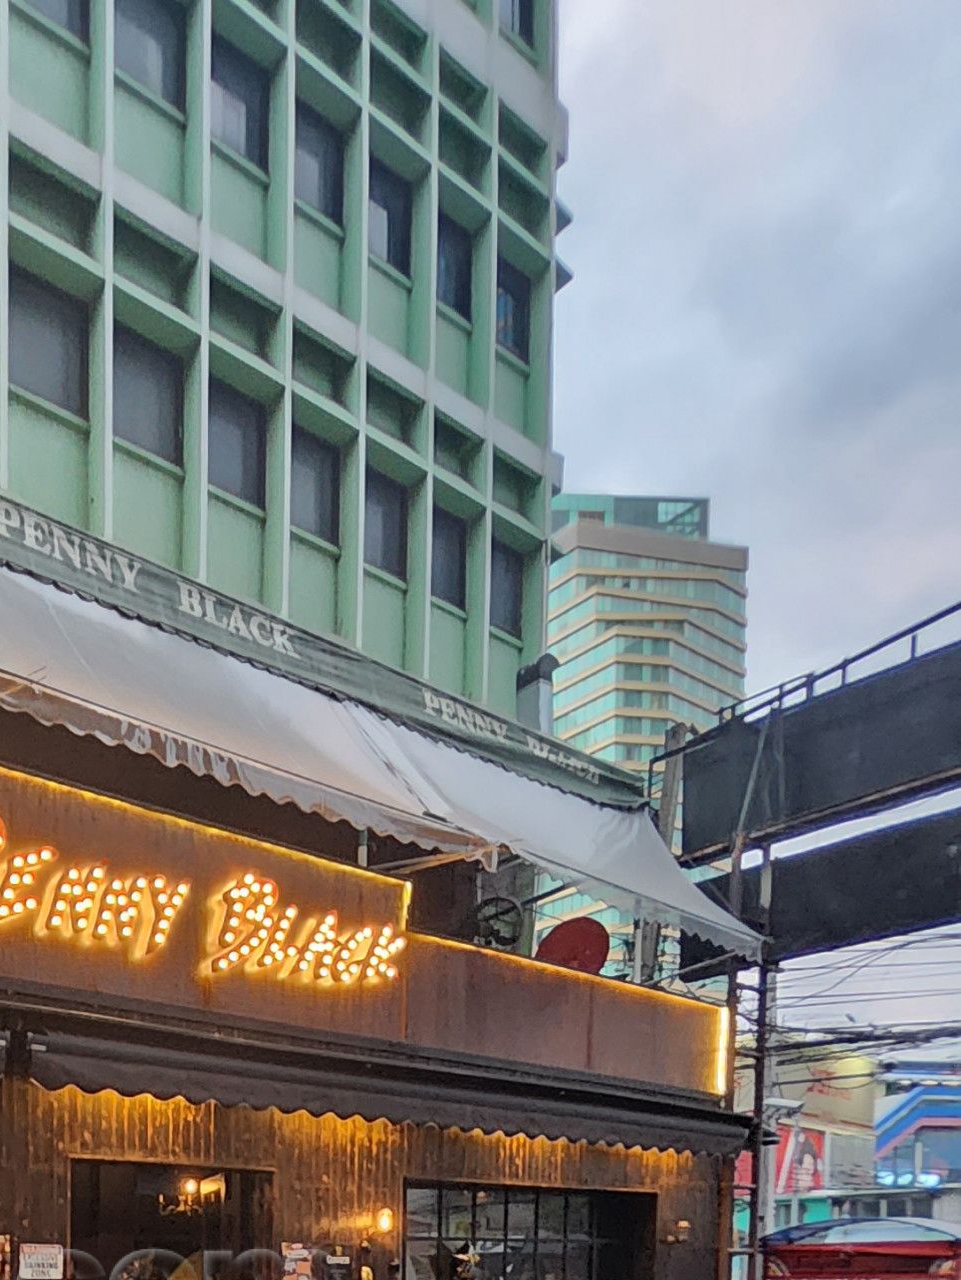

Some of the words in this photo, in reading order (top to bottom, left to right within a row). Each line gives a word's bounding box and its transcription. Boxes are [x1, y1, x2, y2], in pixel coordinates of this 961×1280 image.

[176, 580, 300, 658] BLACK
[422, 687, 508, 743] PENNY
[202, 870, 408, 986] BLACK
